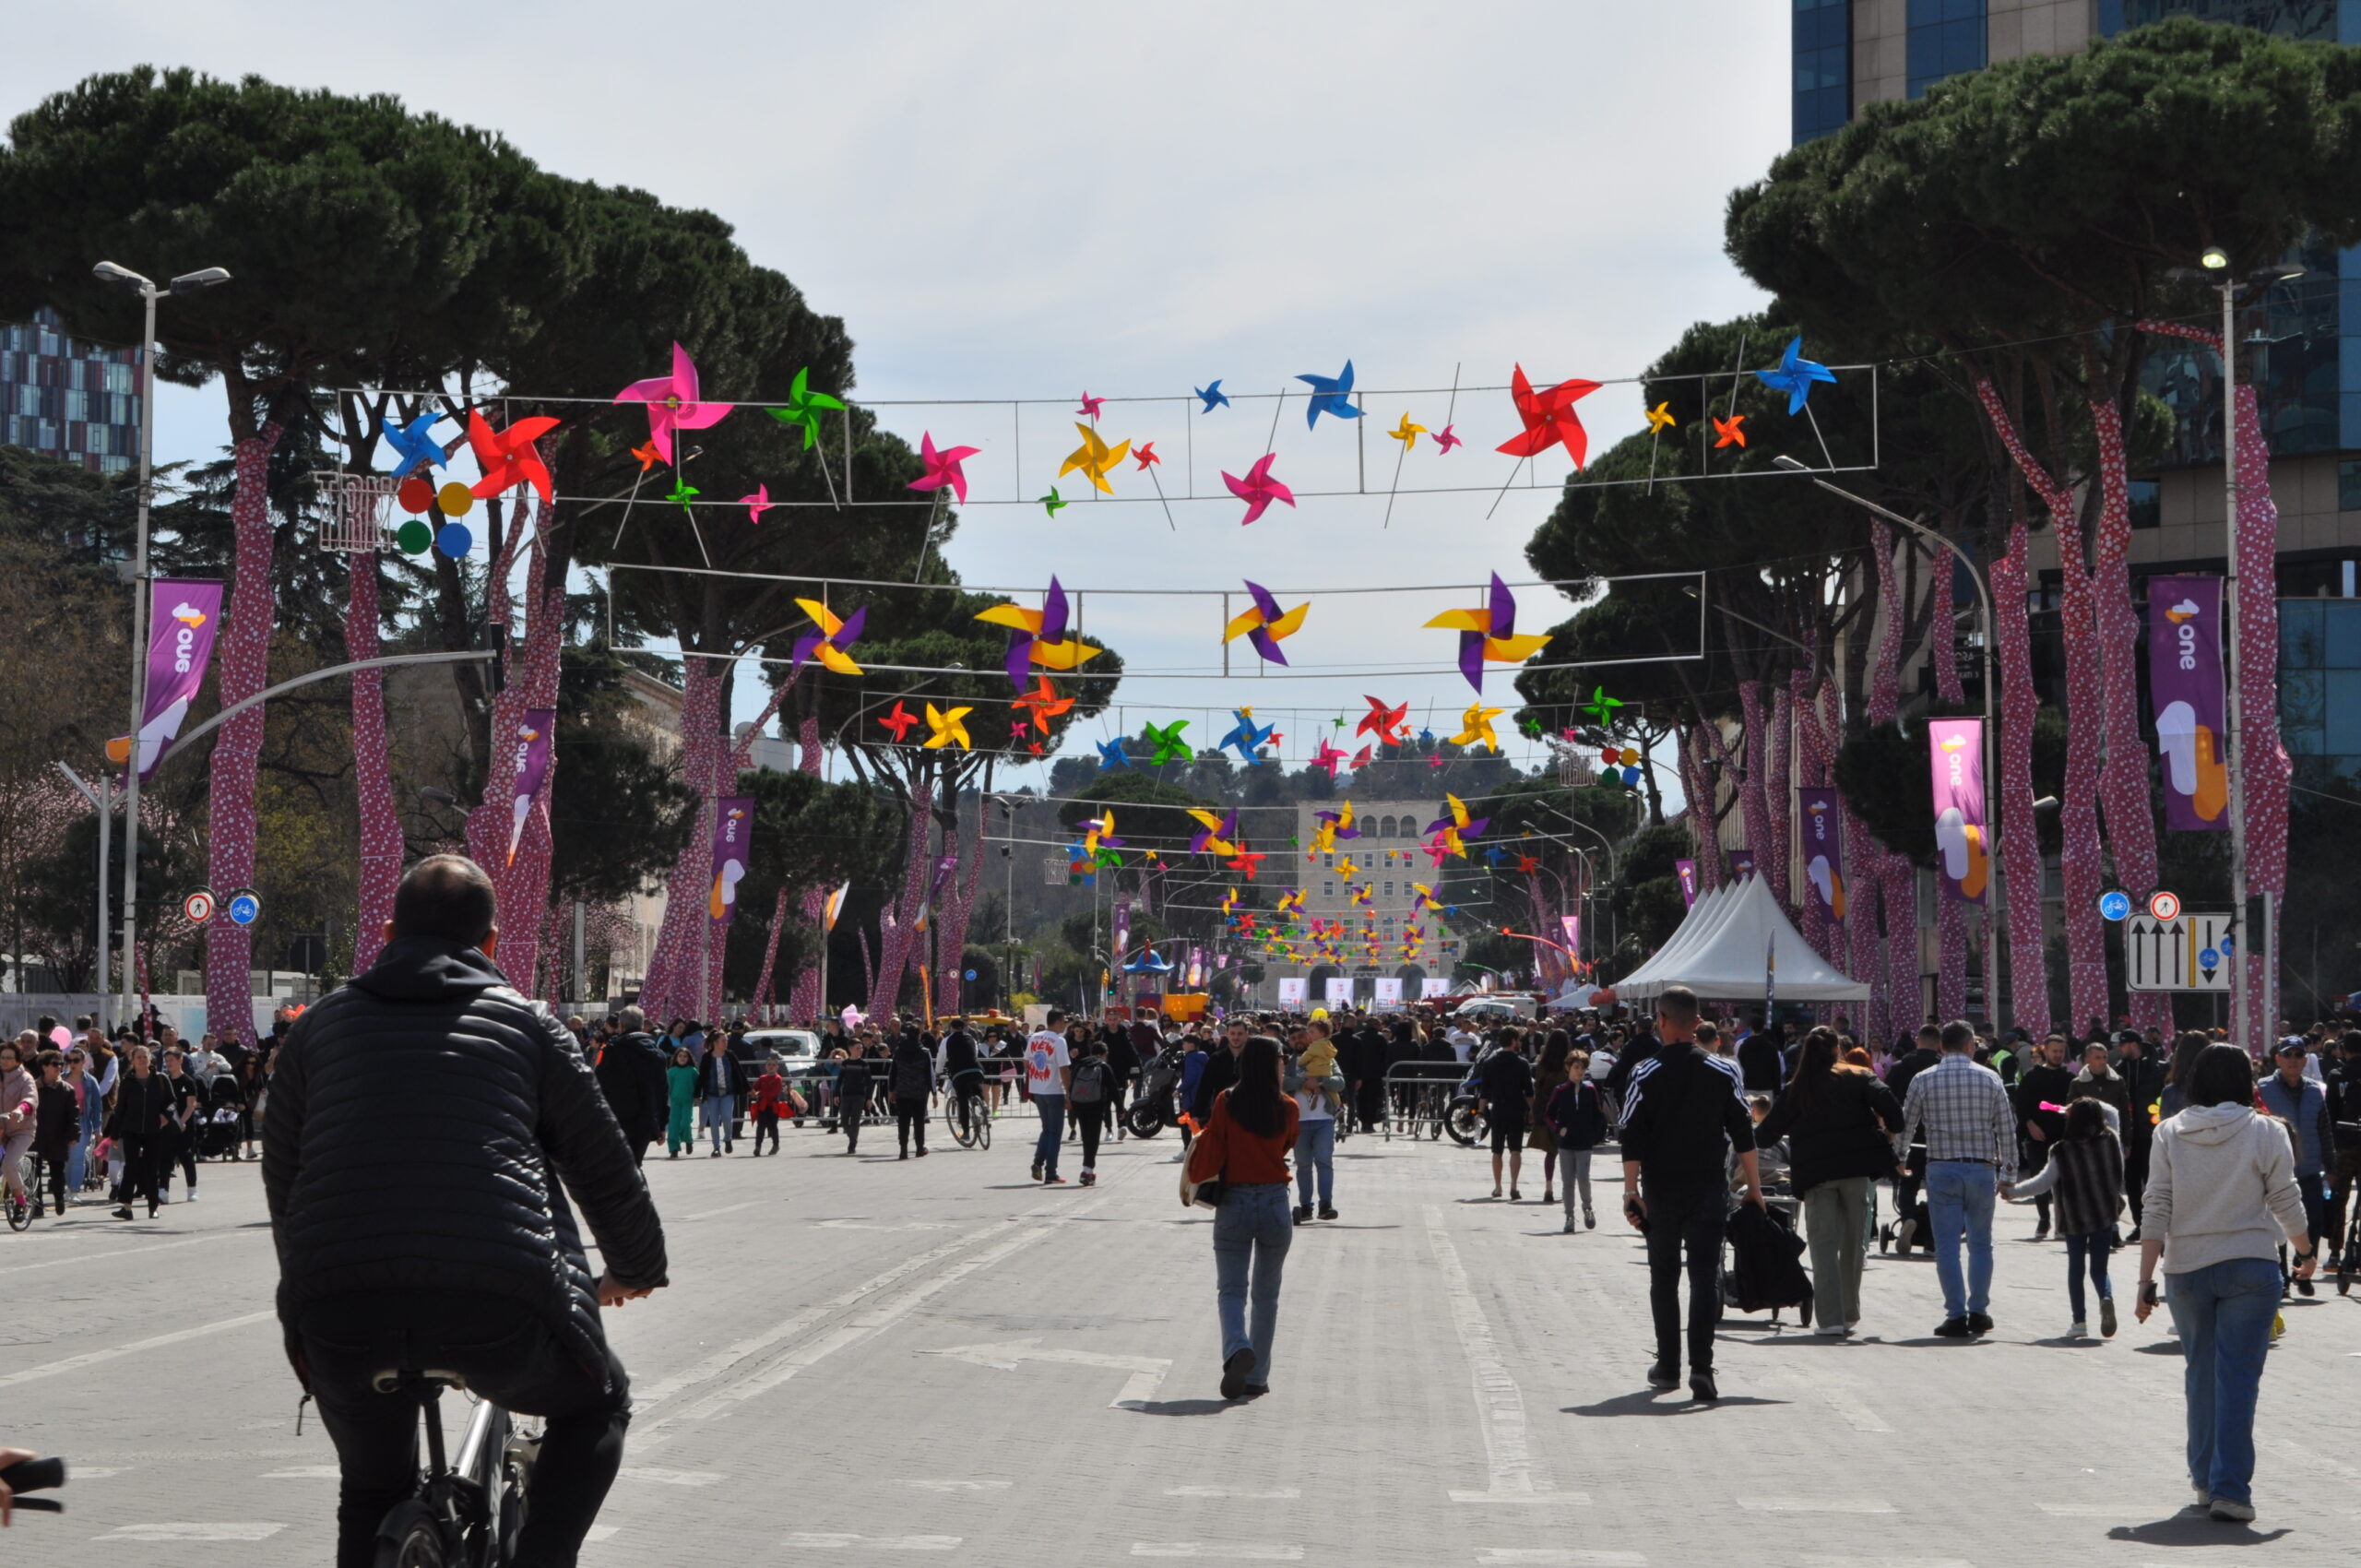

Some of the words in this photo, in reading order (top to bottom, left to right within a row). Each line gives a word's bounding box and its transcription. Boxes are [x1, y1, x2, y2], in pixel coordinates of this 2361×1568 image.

[2178, 624, 2196, 671] one
[1949, 753, 1962, 787] one
[1814, 814, 1825, 840] one
[1030, 1040, 1055, 1056] NEW
